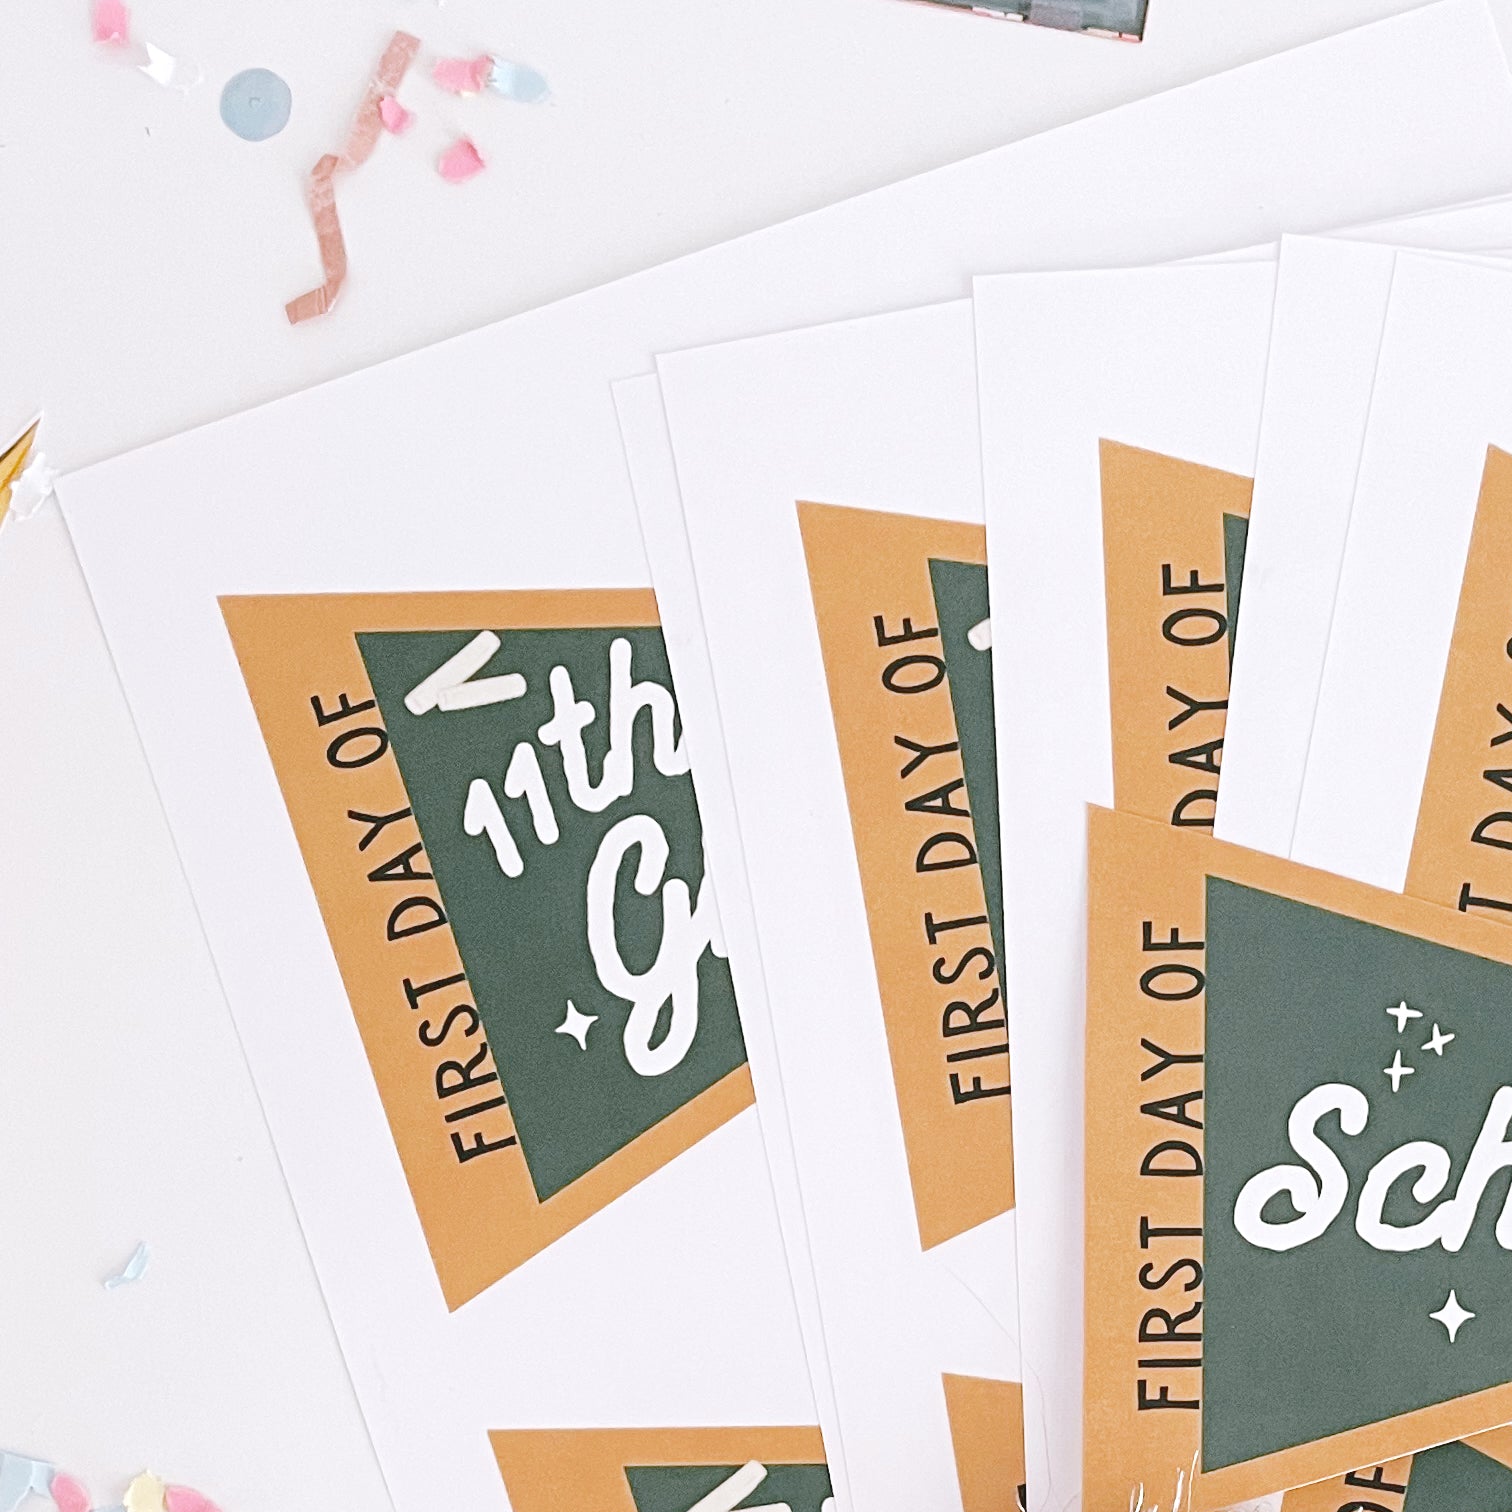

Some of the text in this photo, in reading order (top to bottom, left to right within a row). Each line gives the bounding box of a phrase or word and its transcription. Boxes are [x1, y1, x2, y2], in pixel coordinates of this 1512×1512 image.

[311, 693, 518, 1163] FIRST DAY OF
[463, 637, 692, 878] 11th
[874, 615, 1012, 1105] FIRST DAY OF
[1162, 563, 1229, 827] DAY OF
[1137, 920, 1207, 1411] FIRST DAY OF
